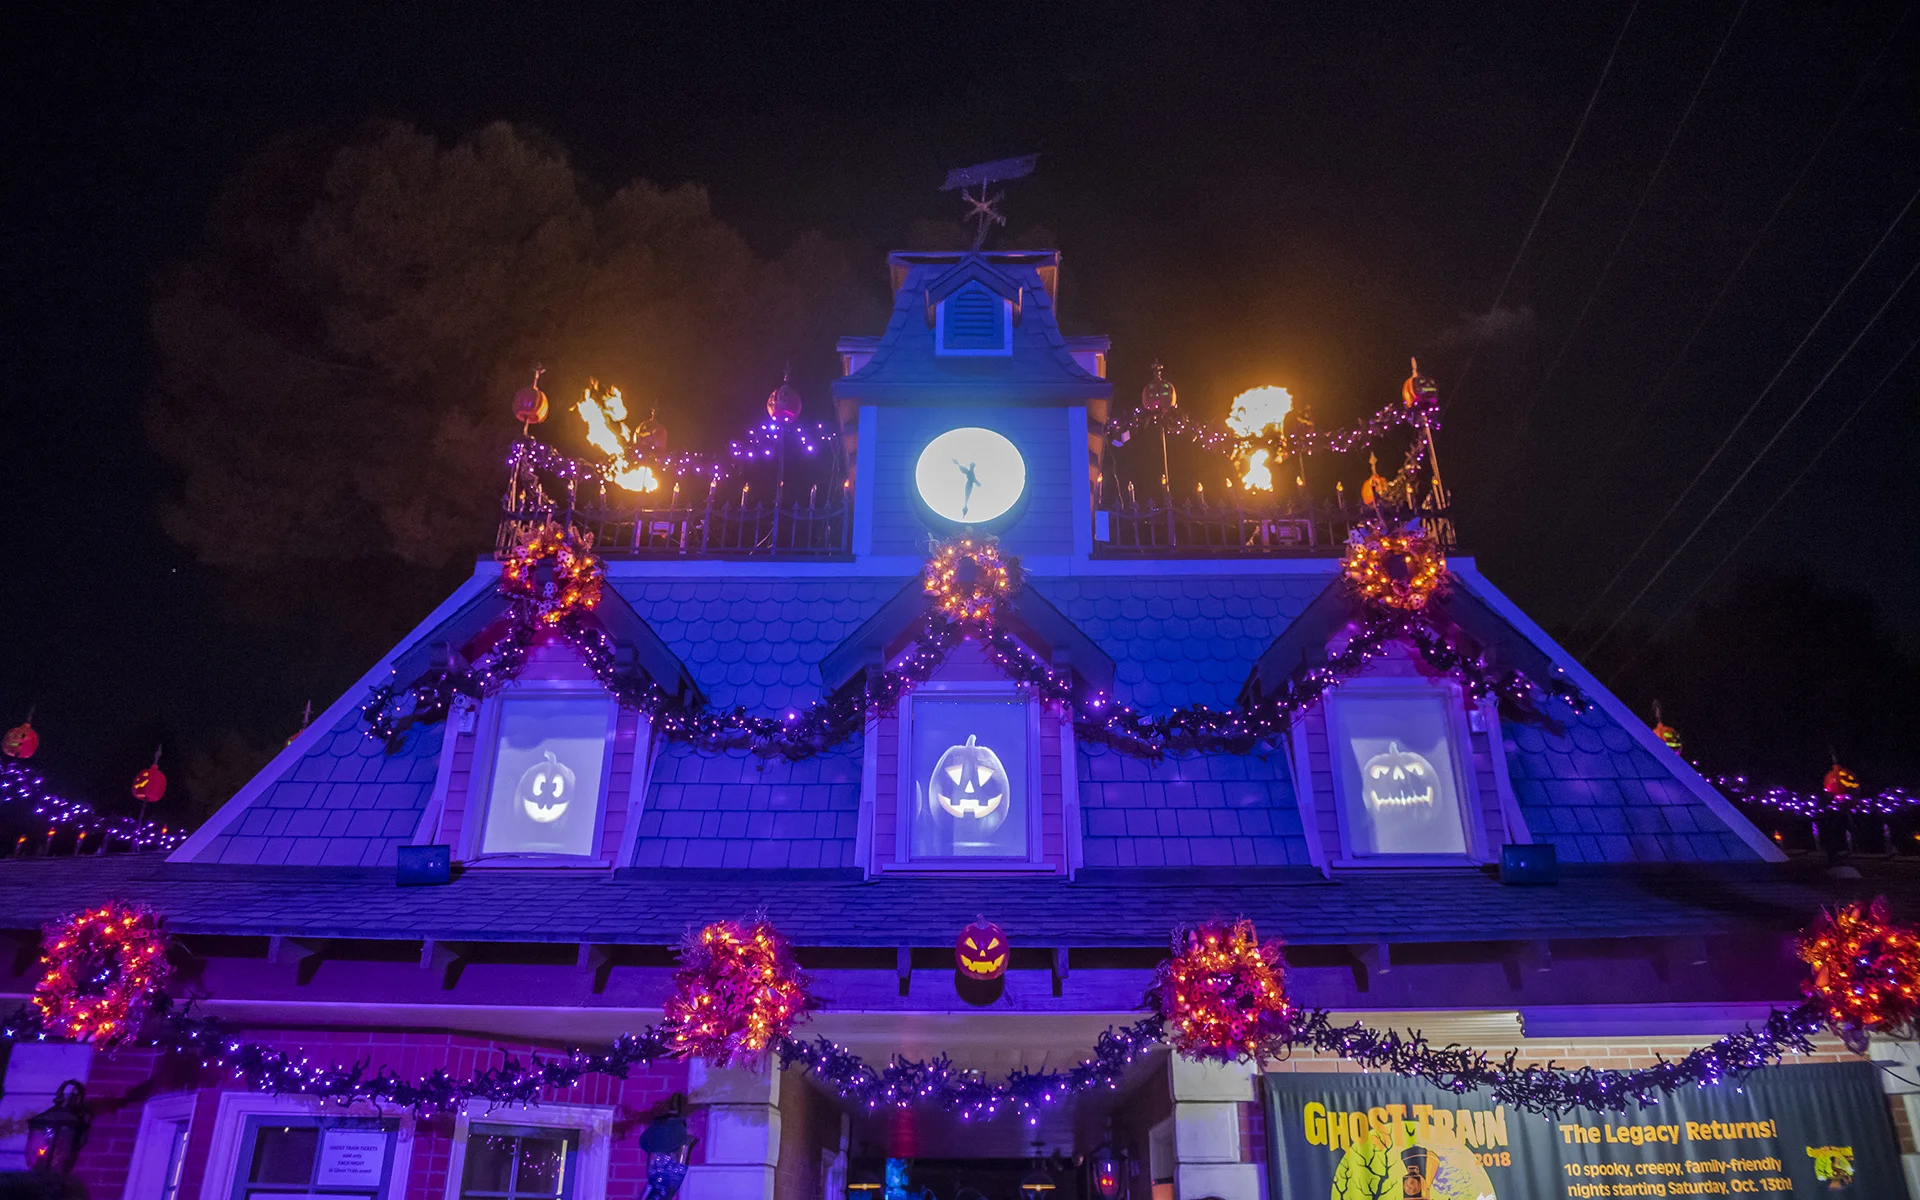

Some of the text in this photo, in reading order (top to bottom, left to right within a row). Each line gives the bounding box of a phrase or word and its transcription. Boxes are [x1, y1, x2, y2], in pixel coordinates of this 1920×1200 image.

[1303, 1101, 1508, 1154] GHOST TRAIN
[1559, 1119, 1778, 1146] The Legacy Returns!
[1475, 1151, 1511, 1167] 2018
[1564, 1157, 1782, 1178] 10 spooky, creepy, family-friendly
[1568, 1182, 1611, 1199] nights
[1613, 1180, 1667, 1198] starting
[1668, 1178, 1729, 1196] Saturday,
[1731, 1178, 1758, 1192] Oct.
